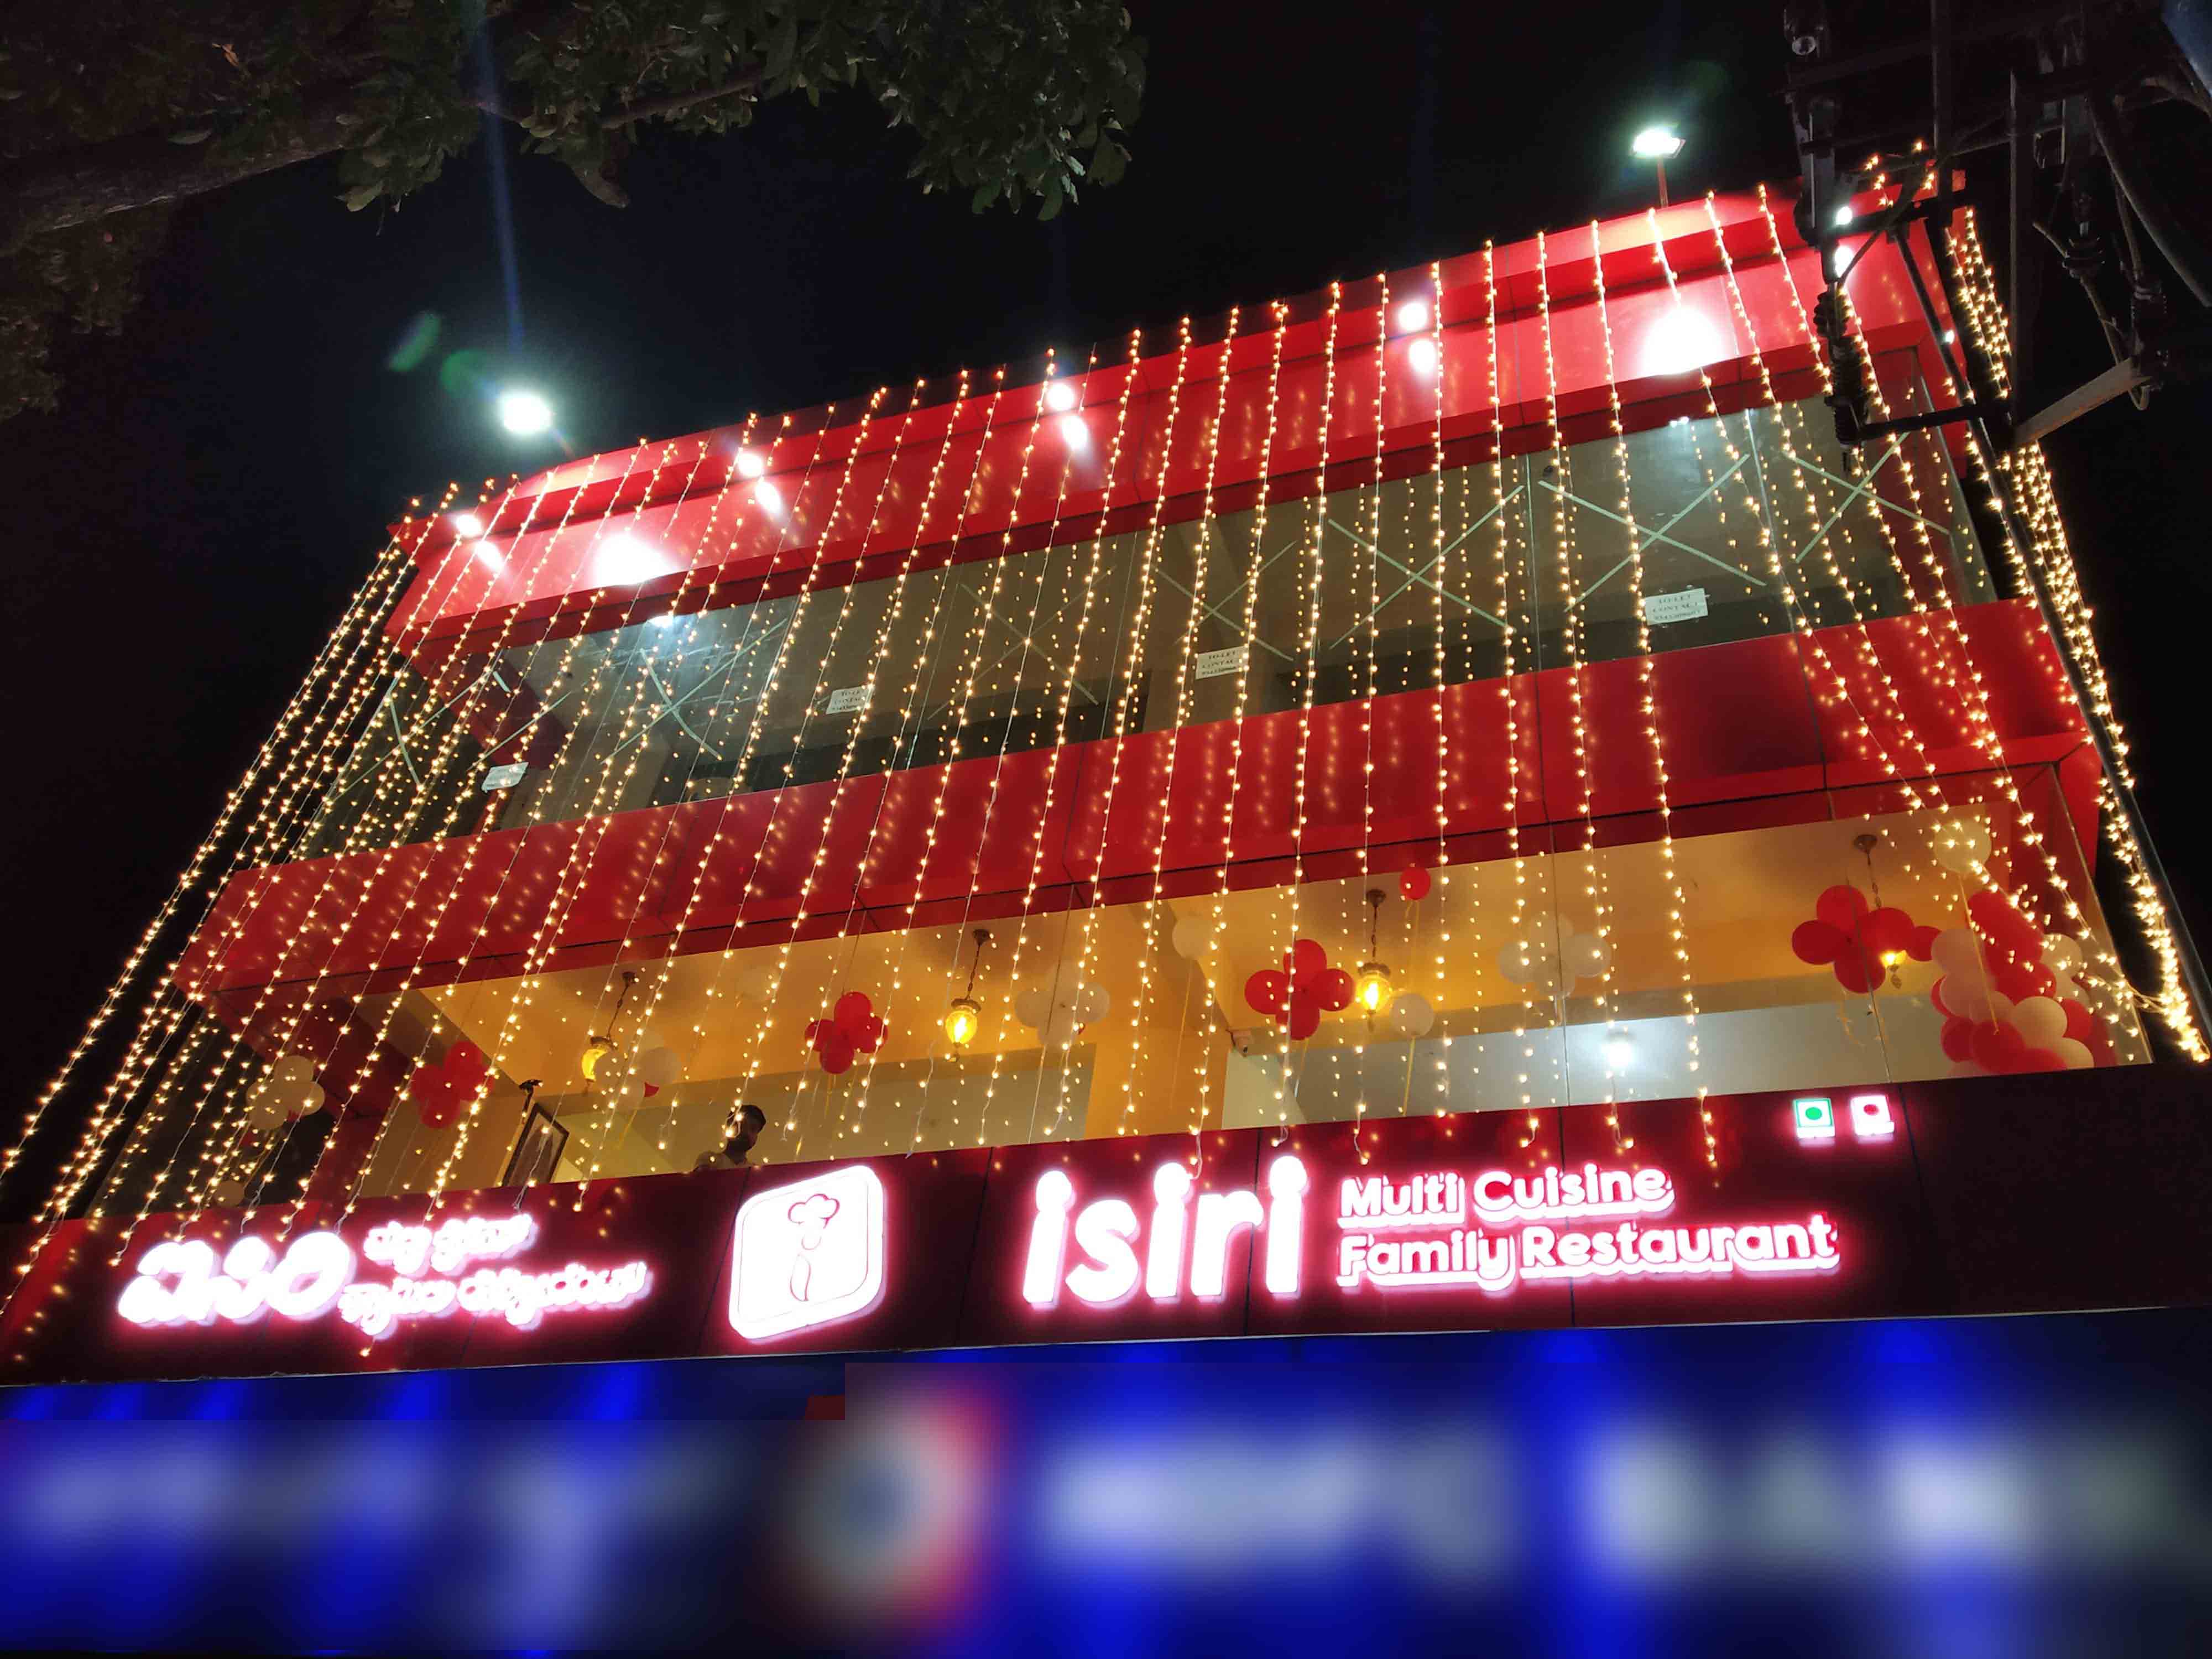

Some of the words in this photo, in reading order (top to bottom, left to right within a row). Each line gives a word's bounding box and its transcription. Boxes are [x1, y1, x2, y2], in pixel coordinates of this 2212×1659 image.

[1024, 1156, 1307, 1303] isiri
[1338, 1173, 1464, 1224] Multi
[1473, 1163, 1674, 1220] Cuisine
[1338, 1230, 1515, 1290] Family
[1521, 1214, 1839, 1276] Restaurant
